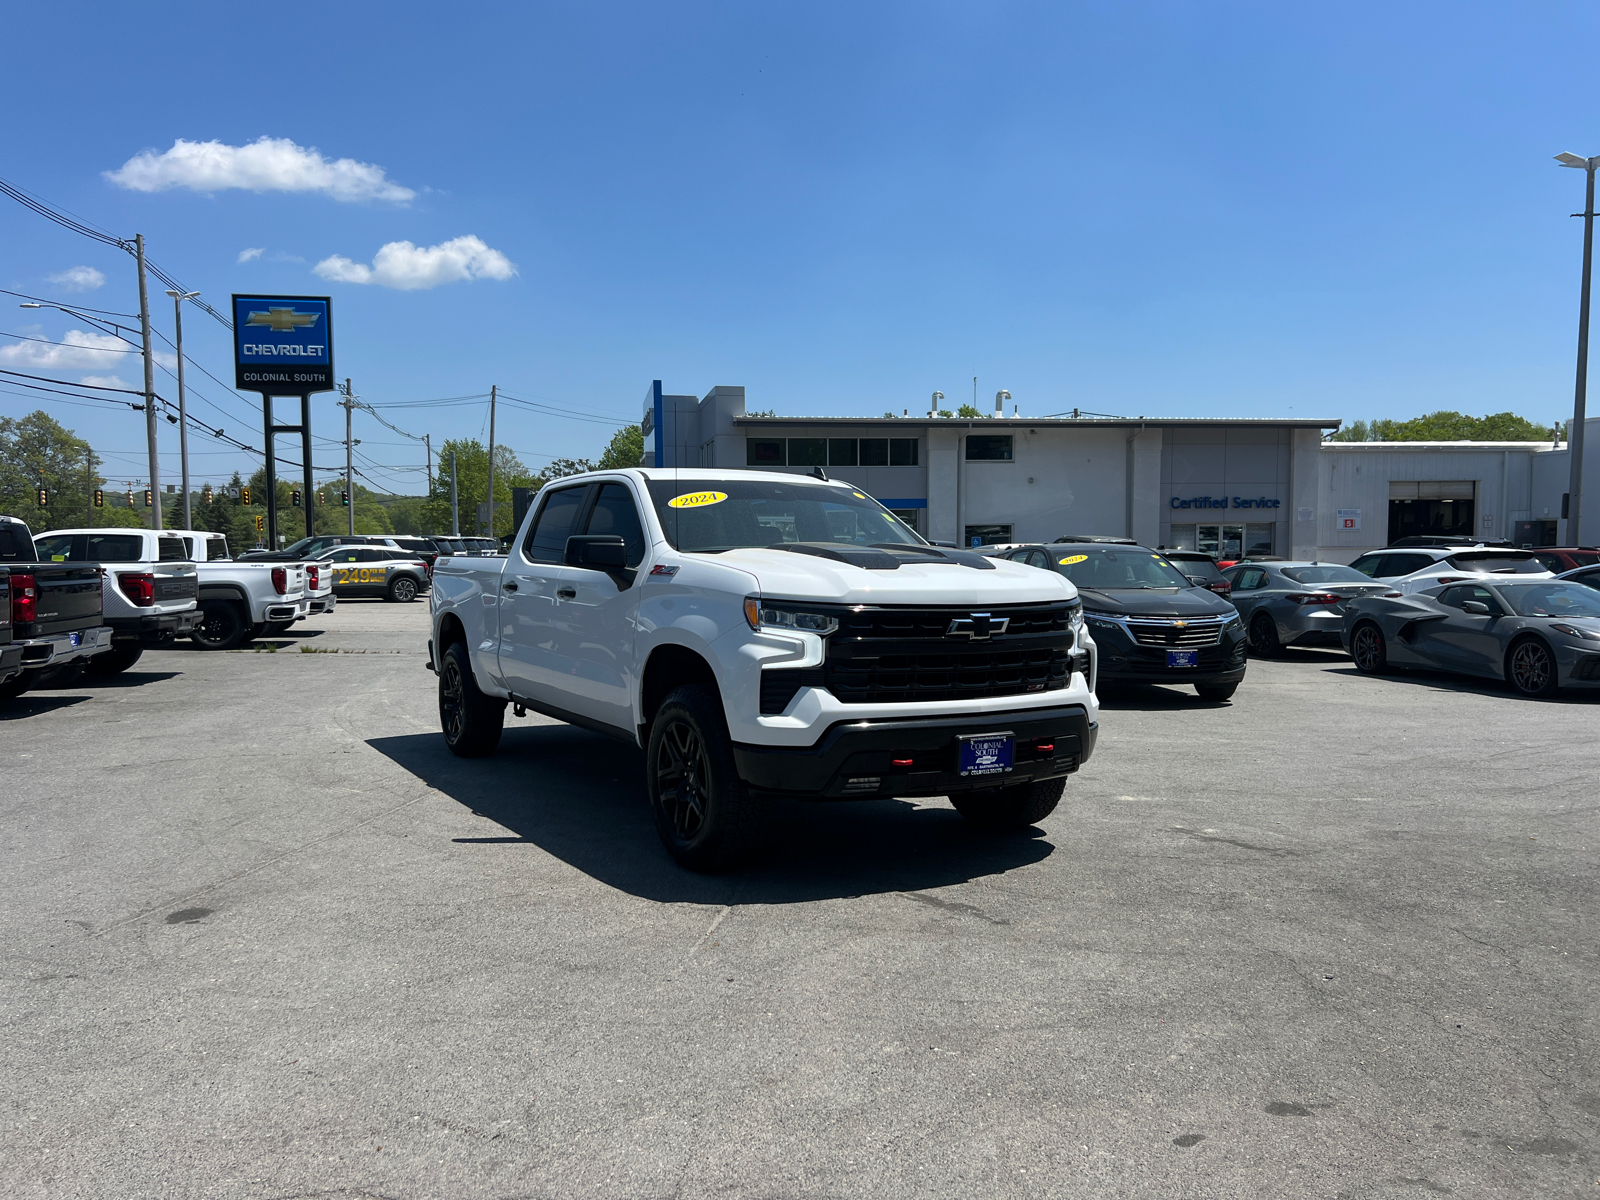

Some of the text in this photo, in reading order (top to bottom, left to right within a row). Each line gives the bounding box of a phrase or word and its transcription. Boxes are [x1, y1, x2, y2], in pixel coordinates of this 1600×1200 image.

[243, 344, 324, 356] CHEVROLET
[243, 373, 326, 382] COLONIAL SOUTH
[680, 493, 718, 506] 2024
[1171, 496, 1280, 509] Certified Service
[162, 584, 195, 594] FORD
[971, 741, 1003, 750] COLONIAL
[975, 748, 998, 756] SOUTH
